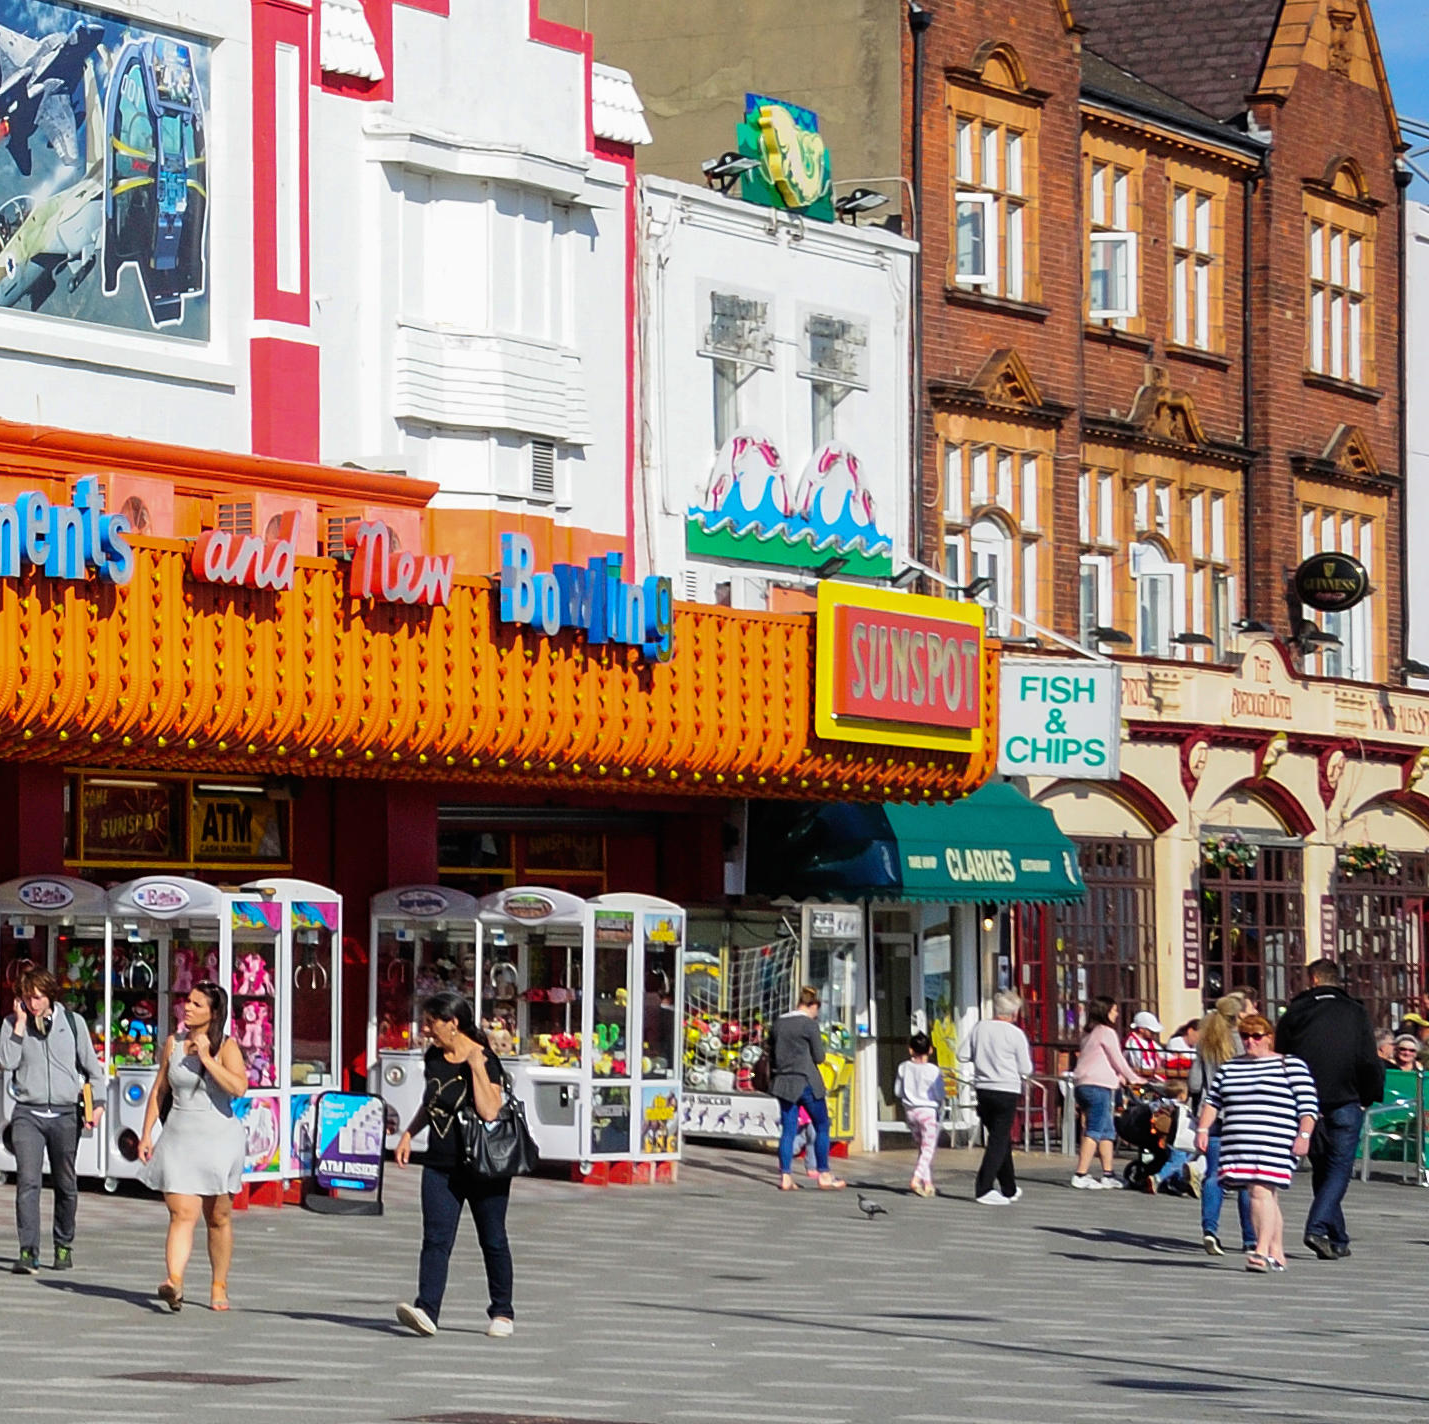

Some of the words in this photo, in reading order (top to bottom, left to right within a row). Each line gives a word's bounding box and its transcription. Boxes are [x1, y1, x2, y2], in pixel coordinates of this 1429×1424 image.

[196, 510, 301, 591] and
[350, 520, 453, 607] New
[501, 533, 674, 663] Bowling
[1303, 577, 1357, 592] GUINNESS
[850, 621, 978, 710] SUNSPOT
[1253, 656, 1272, 684] THE
[1019, 675, 1097, 705] FISH
[1046, 708, 1067, 735] &
[1005, 735, 1107, 768] CHIPS
[100, 810, 160, 840] SUNSPOT
[201, 803, 252, 842] ATM
[945, 847, 1016, 883] CLARKES
[699, 1096, 731, 1108] SOCCER
[319, 1160, 343, 1173] ATM
